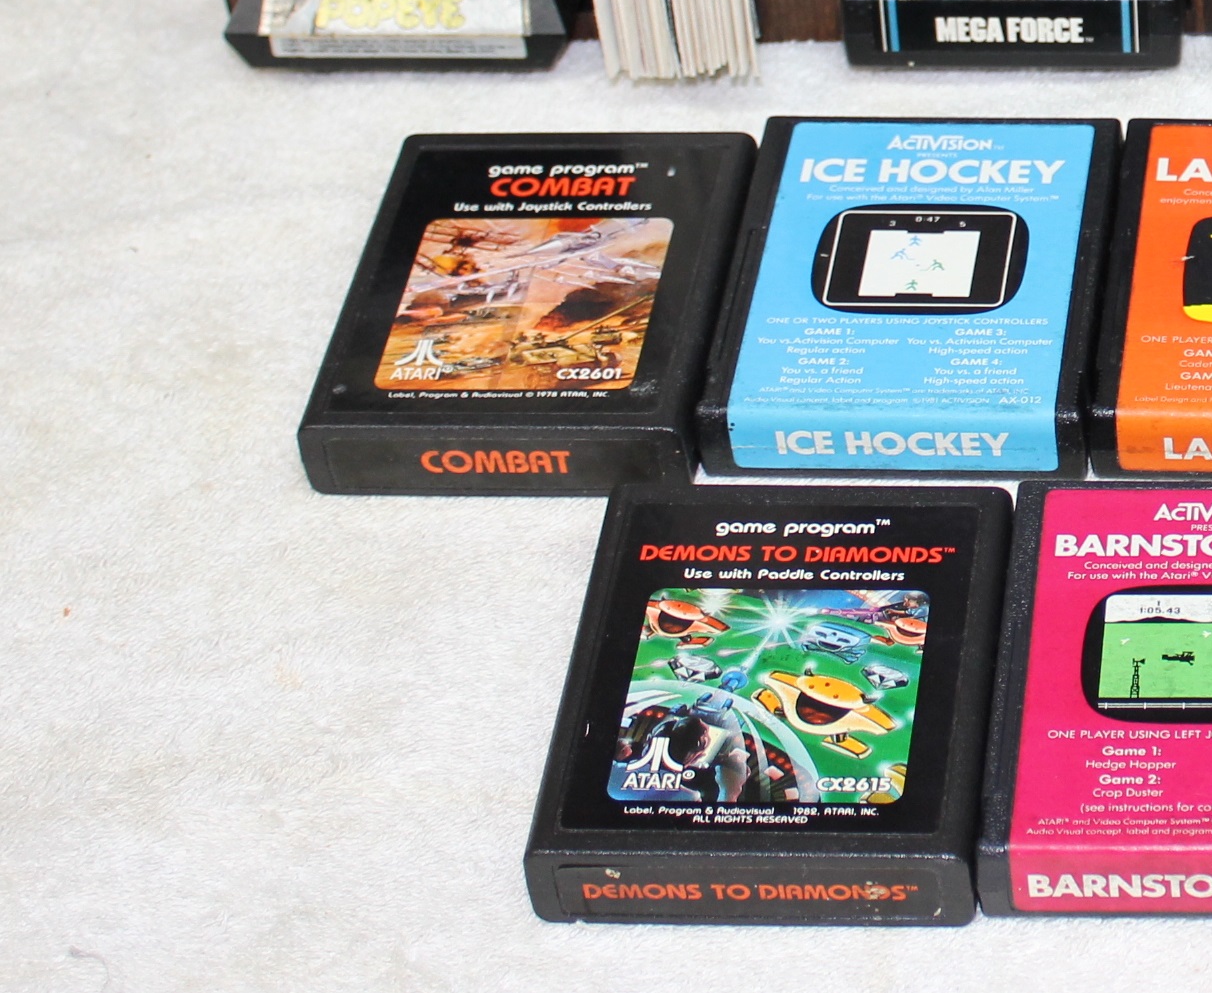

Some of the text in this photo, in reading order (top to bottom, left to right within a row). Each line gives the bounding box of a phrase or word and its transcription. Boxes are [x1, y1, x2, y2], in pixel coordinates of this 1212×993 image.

[935, 17, 1084, 43] MEGA FORCE
[887, 135, 993, 150] ACTIVISION
[800, 159, 1065, 184] ICE HOCKEY
[490, 177, 635, 197] COMBAT
[556, 367, 623, 380] CX2601
[999, 396, 1042, 404] AX-012
[776, 431, 1009, 456] ICE HOCKEY
[420, 450, 570, 474] COMBAT
[640, 545, 751, 561] DEMONS
[762, 546, 797, 561] TO
[1084, 561, 1141, 570] Conceived
[1145, 561, 1167, 570] and
[684, 568, 905, 581] Use with Paddle Controllers
[1102, 746, 1162, 756] Game 1:
[1085, 760, 1176, 771] Hedge Hopper
[816, 777, 892, 792] CX2615
[582, 883, 701, 900] DEMONS
[710, 883, 750, 900] TO
